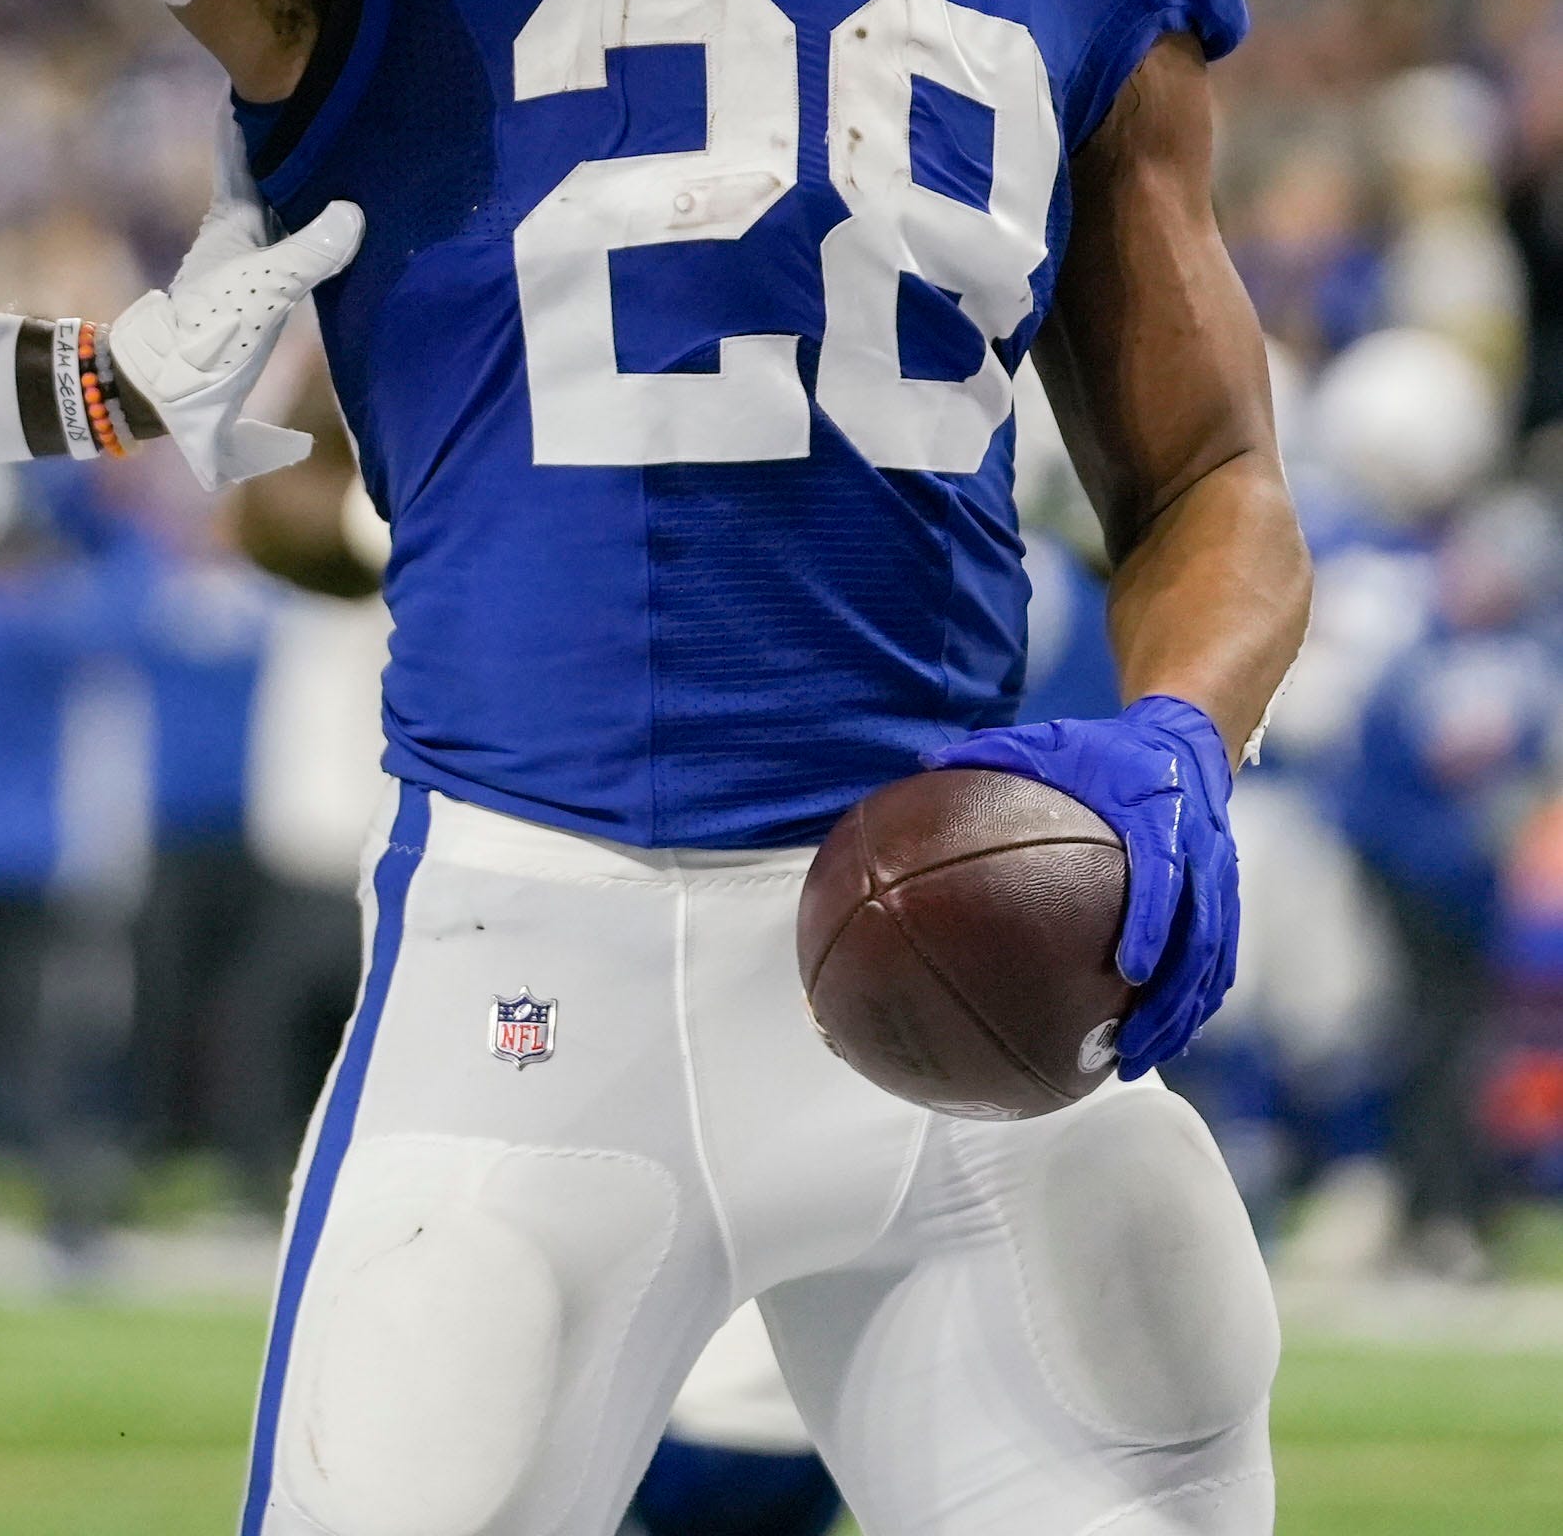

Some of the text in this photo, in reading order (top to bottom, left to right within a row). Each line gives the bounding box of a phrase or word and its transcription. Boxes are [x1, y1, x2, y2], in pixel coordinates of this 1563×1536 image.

[56, 339, 76, 368] AM
[57, 372, 87, 442] SECOND
[500, 1023, 545, 1054] NFL
